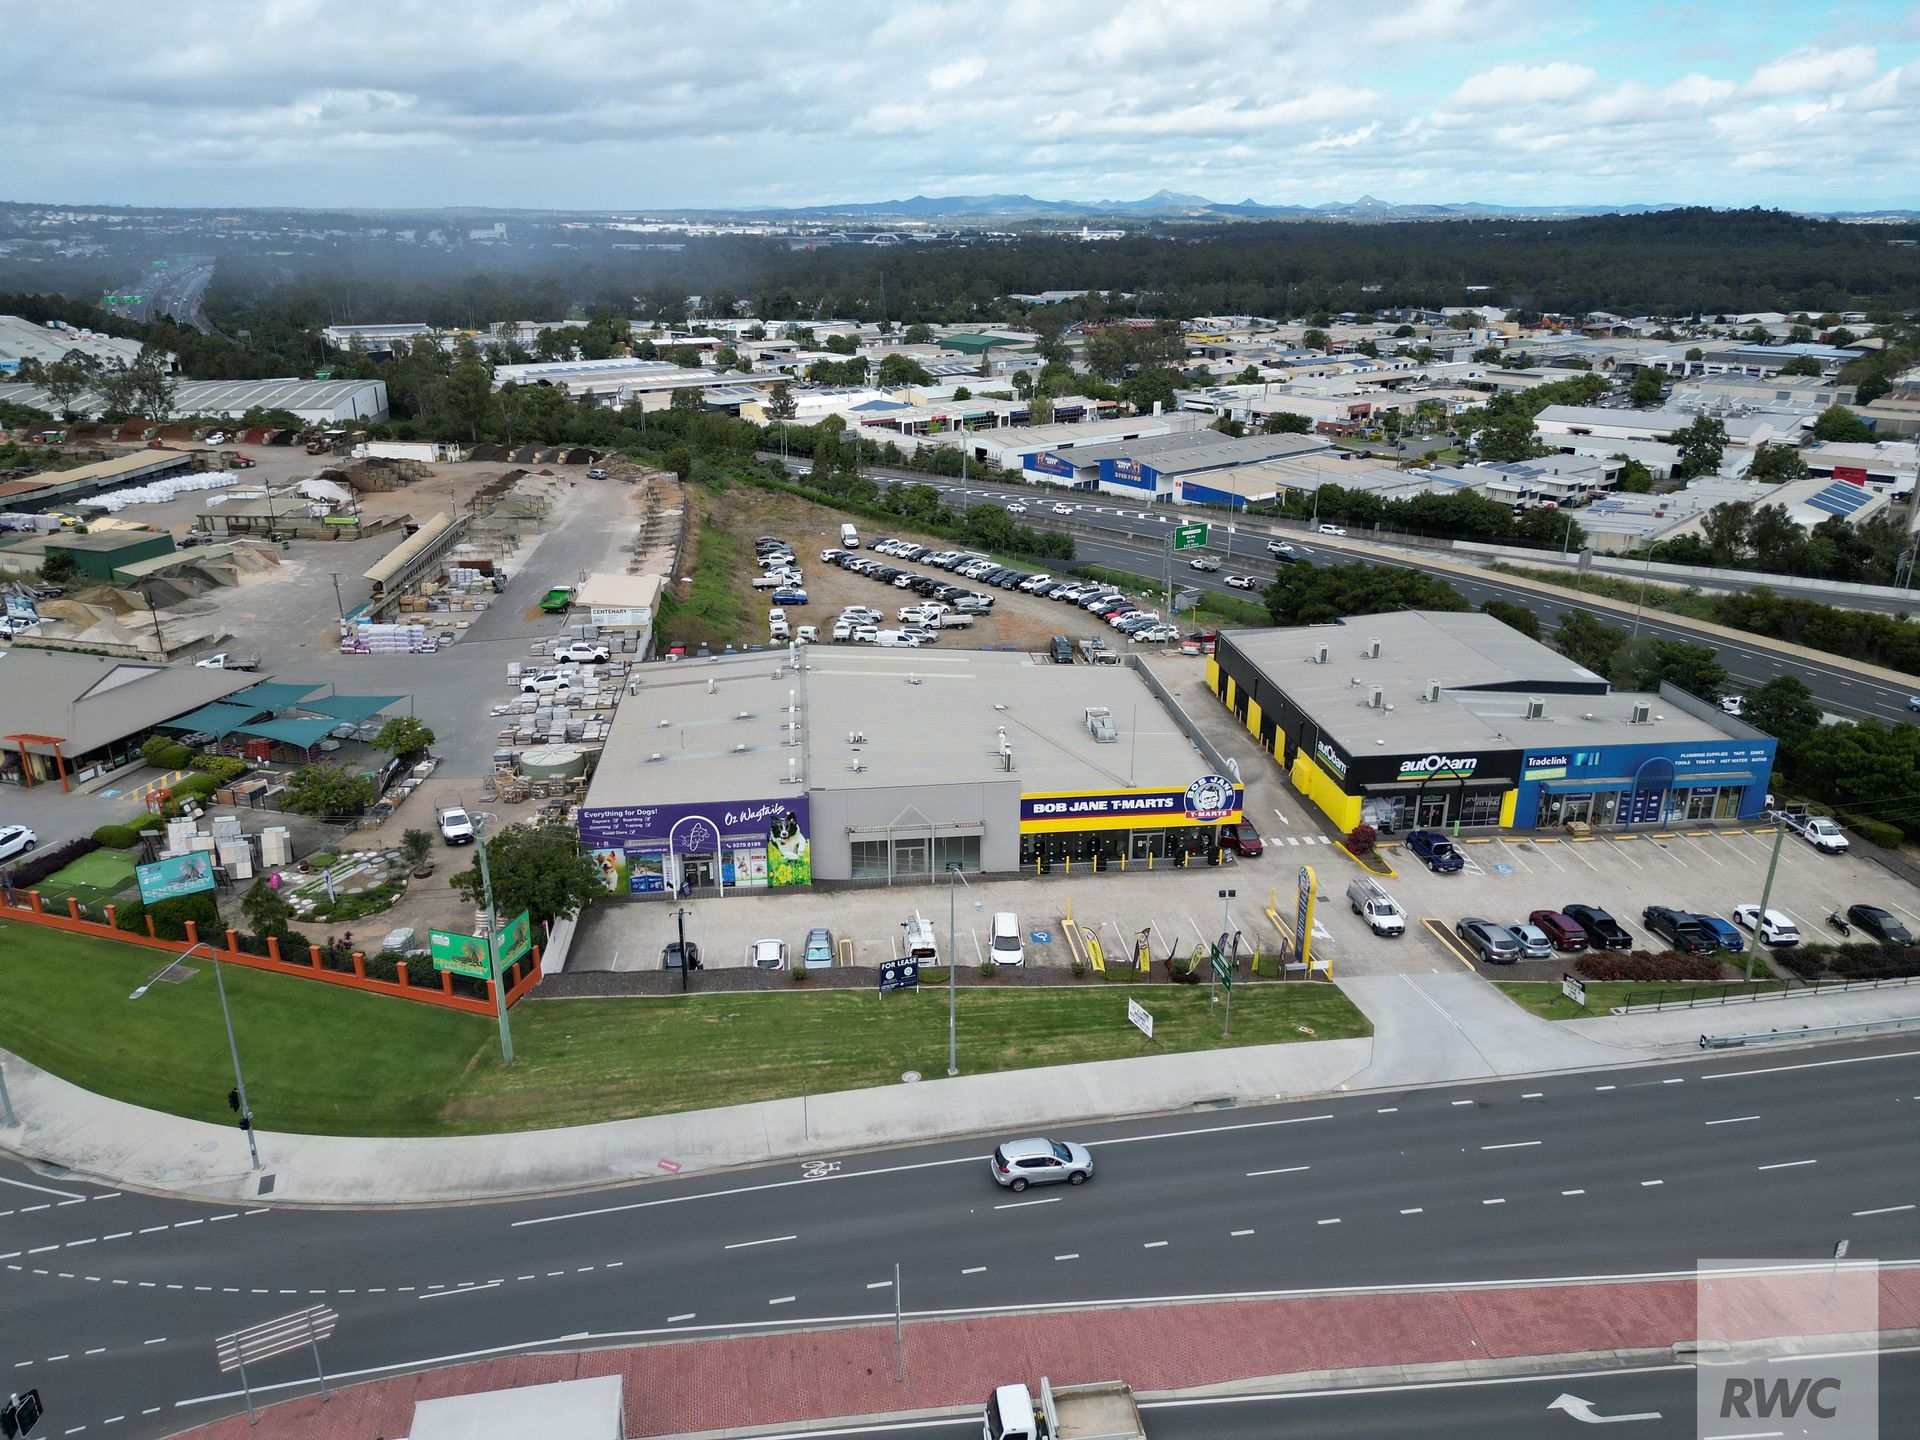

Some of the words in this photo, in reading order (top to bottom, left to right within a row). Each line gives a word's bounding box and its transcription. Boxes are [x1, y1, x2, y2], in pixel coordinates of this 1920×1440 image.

[1528, 756, 1567, 766] Tradelink
[1187, 778, 1206, 798] BOB
[1210, 777, 1232, 797] JANE
[584, 810, 623, 818] Everything
[636, 808, 658, 816] Dogs!
[1034, 802, 1067, 814] BOB
[1070, 801, 1108, 812] JANE
[1111, 798, 1174, 810] T-MARTS
[724, 812, 738, 826] Oz
[740, 803, 785, 822] Wagtails
[882, 962, 896, 970] FOR
[897, 957, 917, 966] LEASE
